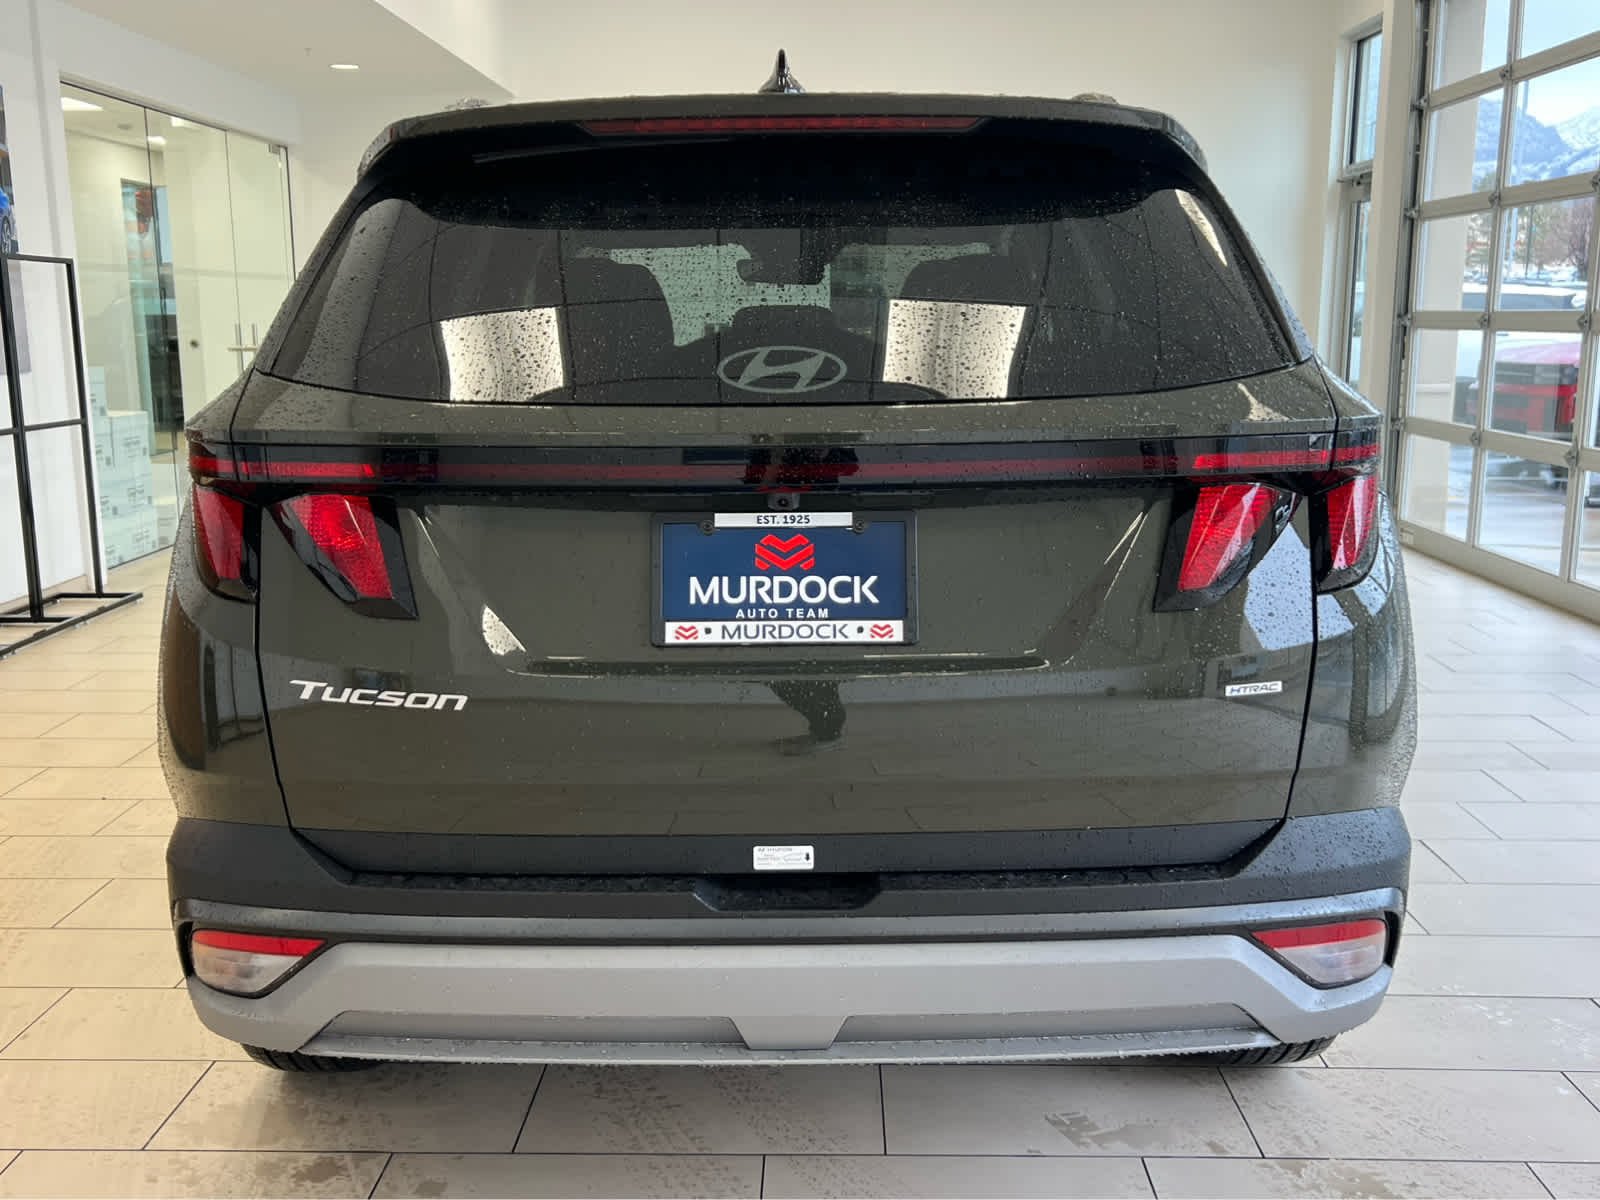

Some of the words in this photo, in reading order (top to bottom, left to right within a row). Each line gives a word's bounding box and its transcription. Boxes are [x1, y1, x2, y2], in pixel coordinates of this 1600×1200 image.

[756, 515, 780, 525] EST.
[782, 514, 811, 525] 1925
[689, 575, 880, 605] MURDOCK
[735, 608, 778, 619] AUTO
[786, 608, 829, 619] TEAM
[721, 623, 849, 640] MURDOCK
[1230, 682, 1280, 694] HTRAC
